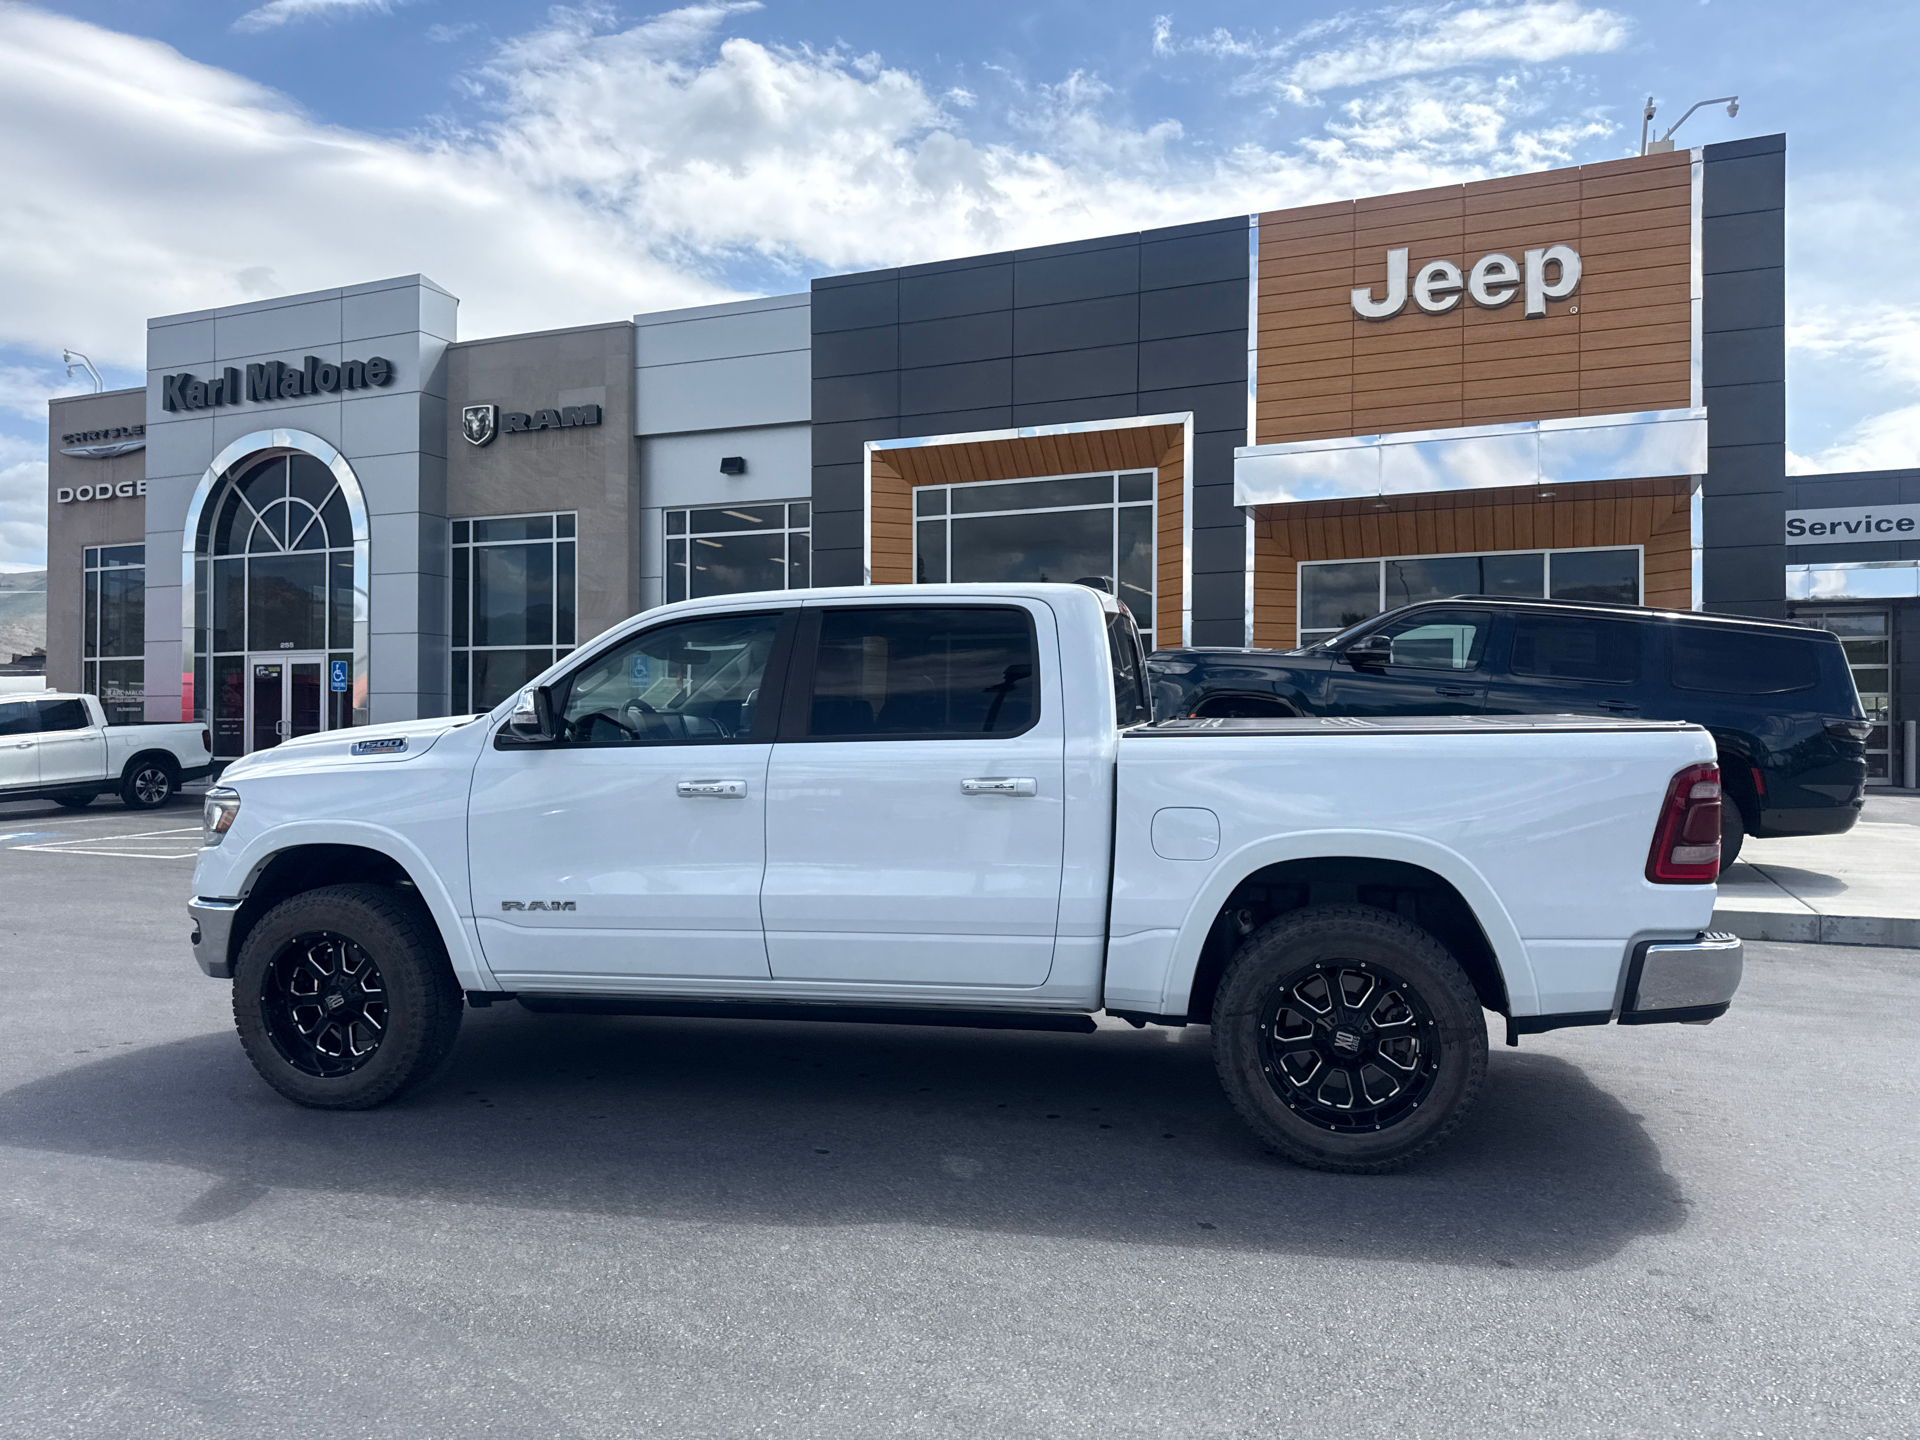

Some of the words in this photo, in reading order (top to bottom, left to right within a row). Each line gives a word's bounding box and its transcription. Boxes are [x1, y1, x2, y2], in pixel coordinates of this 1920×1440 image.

[1351, 244, 1582, 320] Jeep
[163, 367, 238, 411] Karl
[246, 356, 392, 401] Malone
[501, 404, 602, 433] RAM
[57, 480, 146, 503] DODGE
[1786, 515, 1915, 537] Service
[360, 740, 401, 748] 1500
[502, 901, 576, 911] RAM
